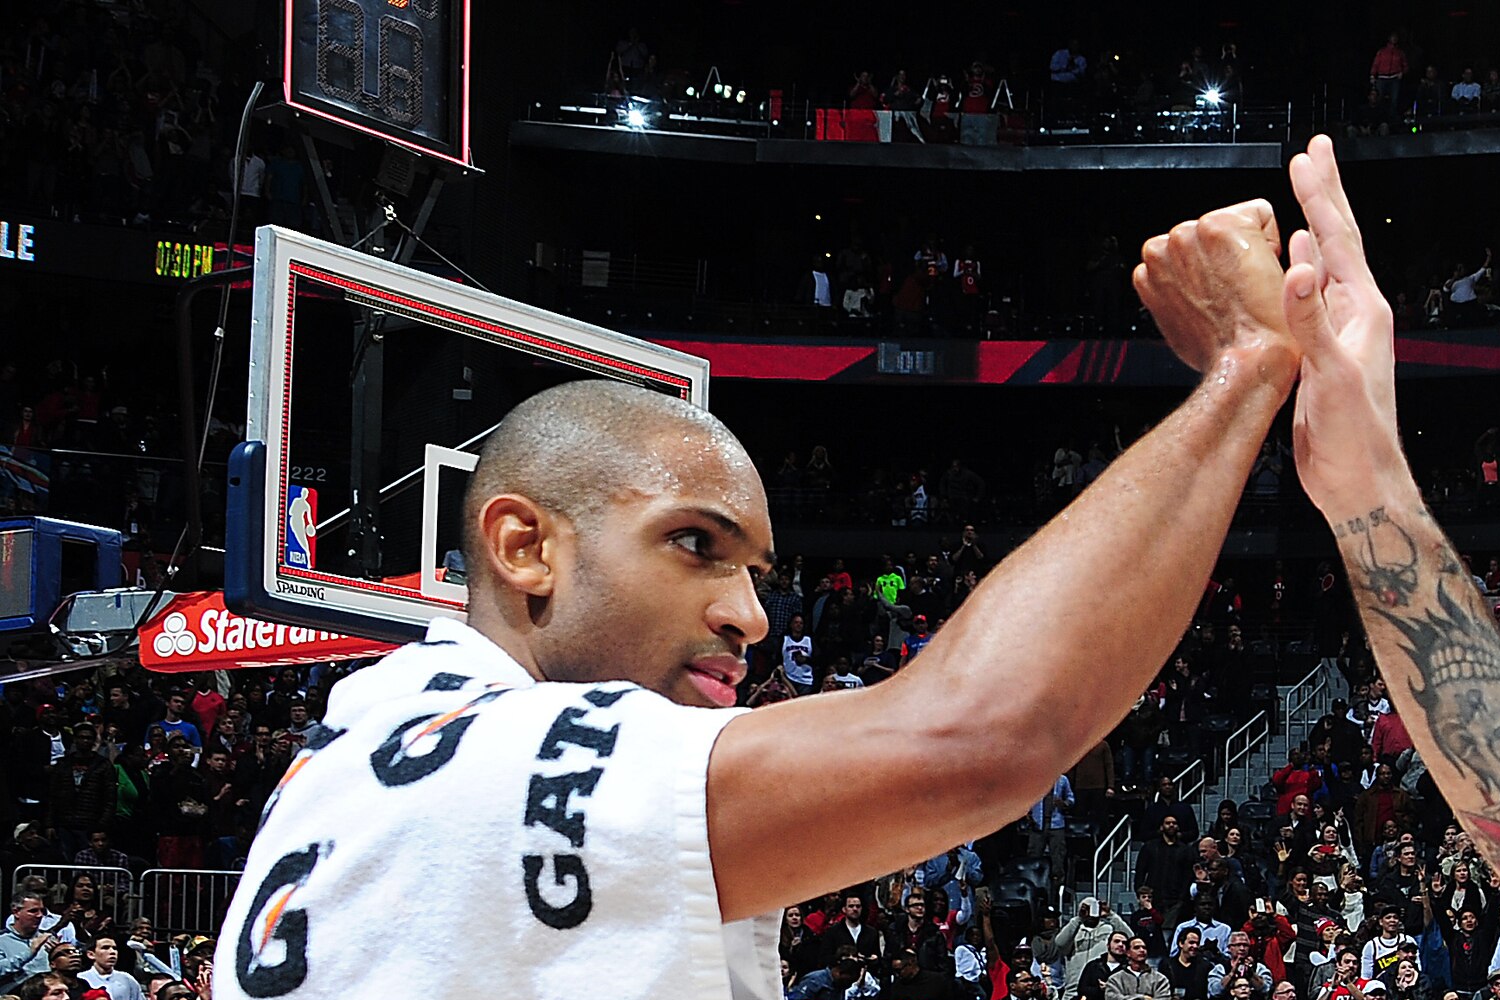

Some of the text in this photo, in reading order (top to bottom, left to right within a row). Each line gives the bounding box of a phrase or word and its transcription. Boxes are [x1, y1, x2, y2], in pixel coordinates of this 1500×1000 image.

[193, 244, 213, 278] PM
[291, 466, 327, 482] 222
[289, 551, 307, 564] NBA
[276, 580, 325, 601] SPALDING
[522, 687, 642, 930] GAT
